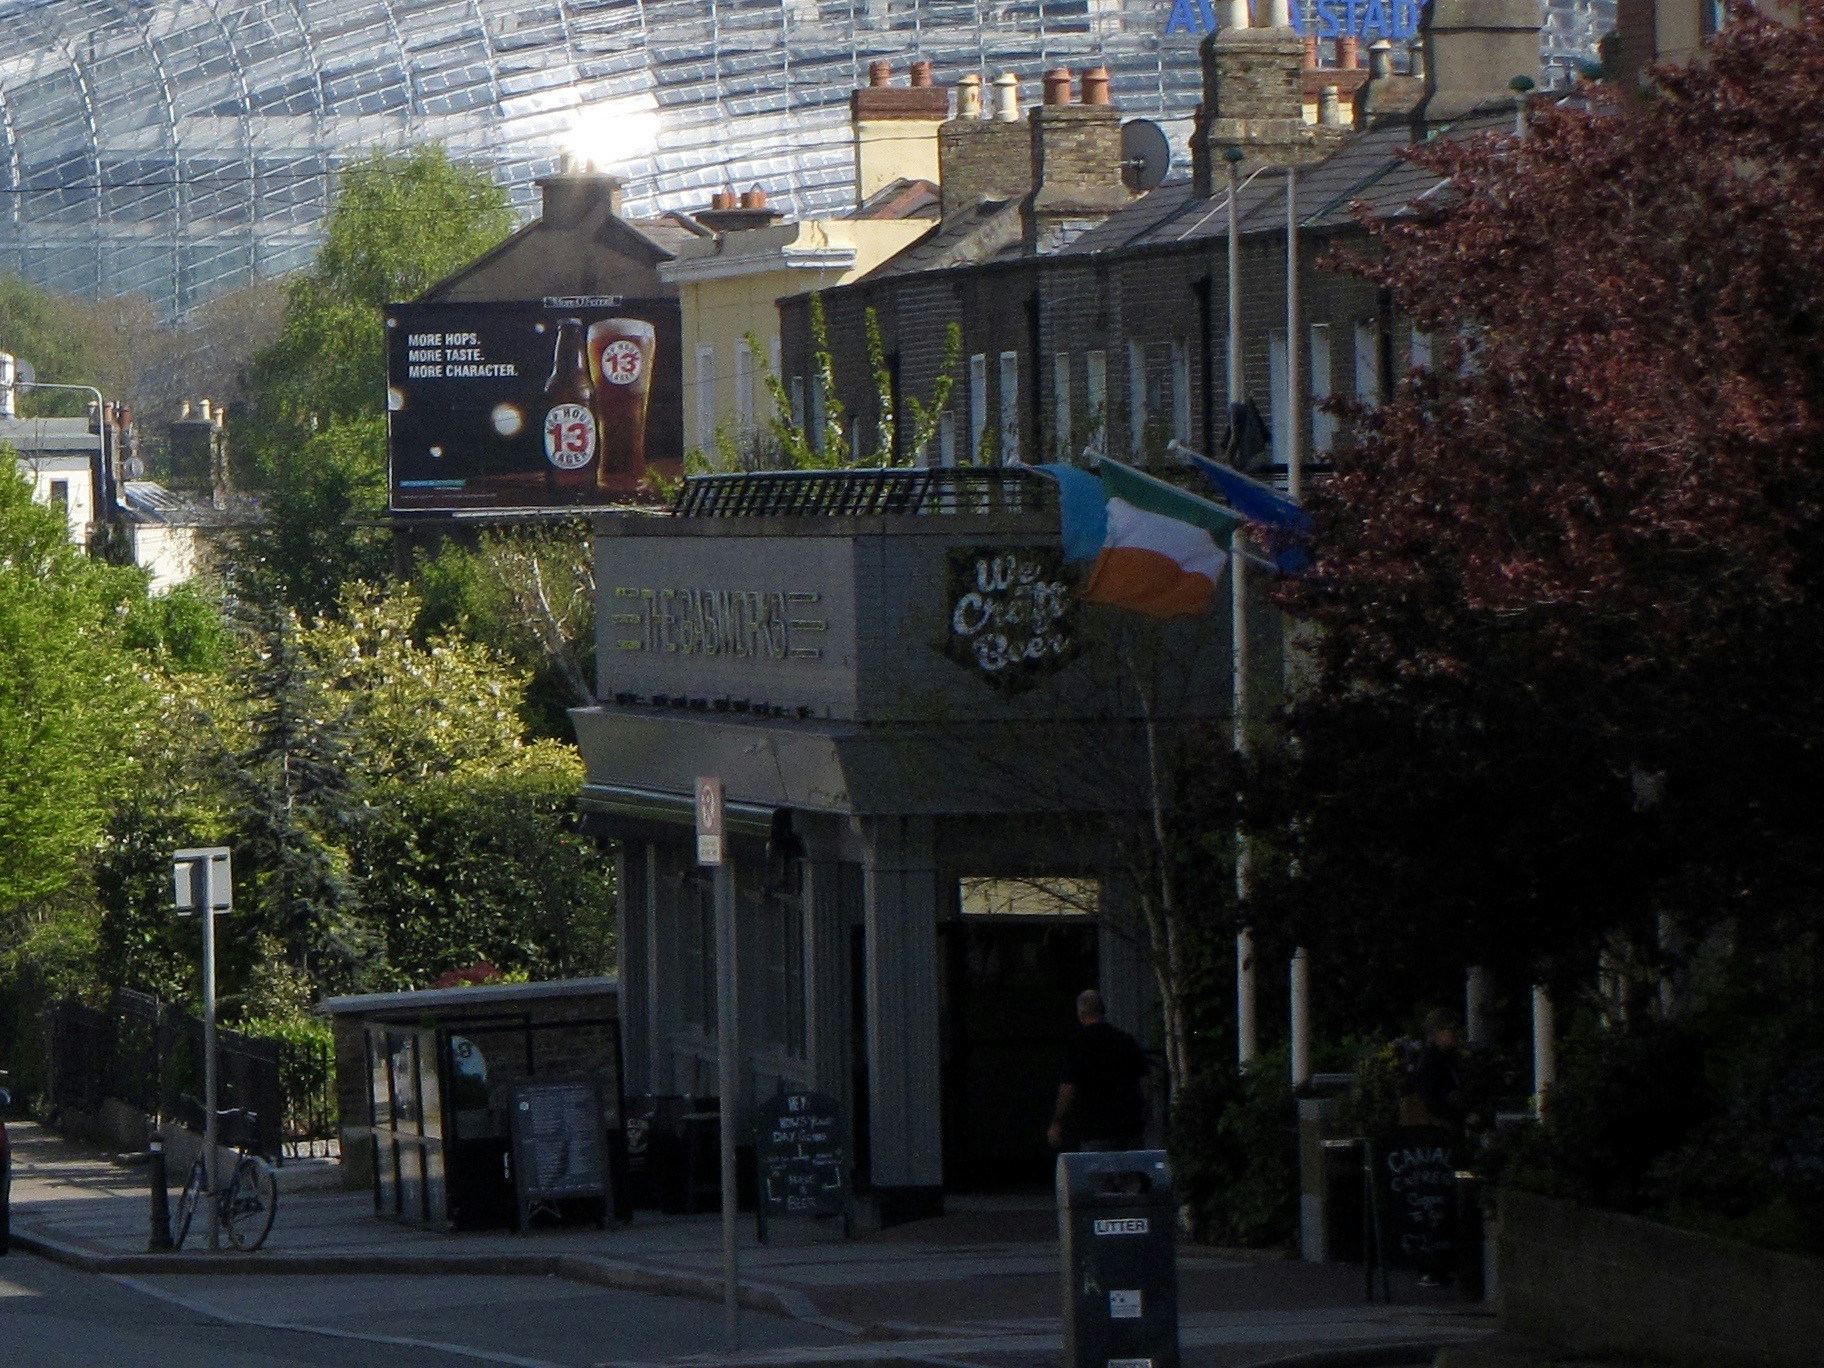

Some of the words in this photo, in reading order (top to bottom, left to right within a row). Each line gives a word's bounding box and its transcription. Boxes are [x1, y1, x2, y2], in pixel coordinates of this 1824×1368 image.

[408, 334, 442, 347] MORE
[445, 332, 481, 346] HOPS.
[408, 349, 442, 362] MORE
[445, 348, 485, 361] TASTE.
[605, 352, 636, 373] 13
[409, 365, 442, 378] MORE
[445, 364, 518, 377] CHARACTER.
[547, 422, 589, 453] 13
[1096, 1220, 1146, 1233] LITTER
